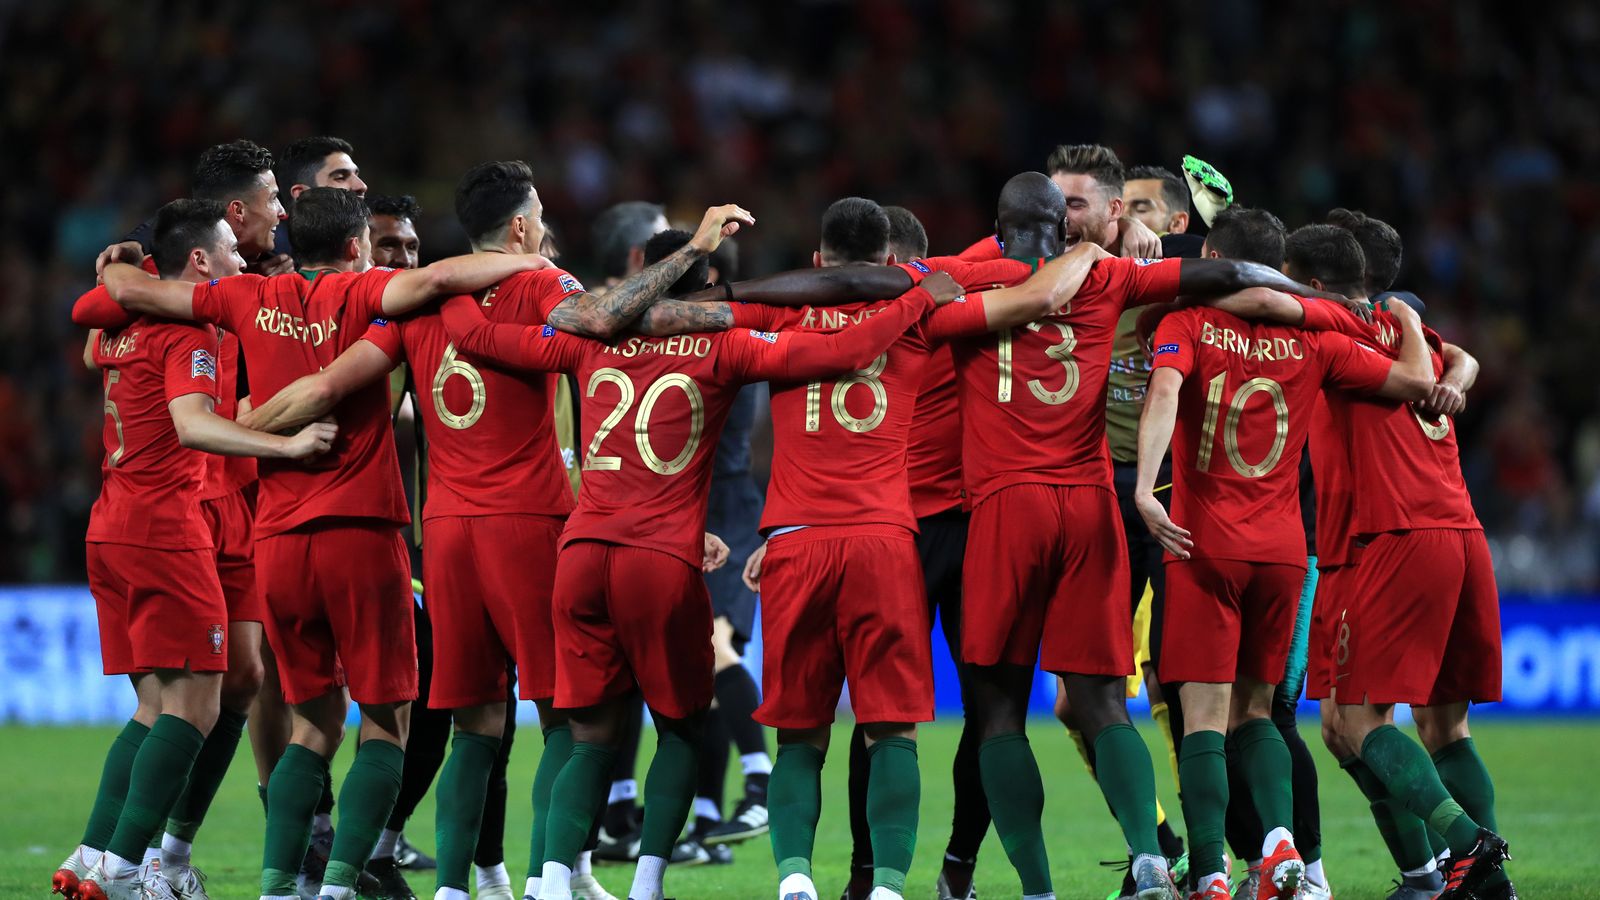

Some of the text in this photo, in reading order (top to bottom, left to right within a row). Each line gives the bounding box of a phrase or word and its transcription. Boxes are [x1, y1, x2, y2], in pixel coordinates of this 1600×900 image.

[432, 341, 486, 430] 6
[998, 320, 1080, 405] 13
[1200, 321, 1304, 363] BERNARDO
[583, 367, 704, 476] 20
[805, 352, 888, 433] 18
[1197, 370, 1289, 478] 10
